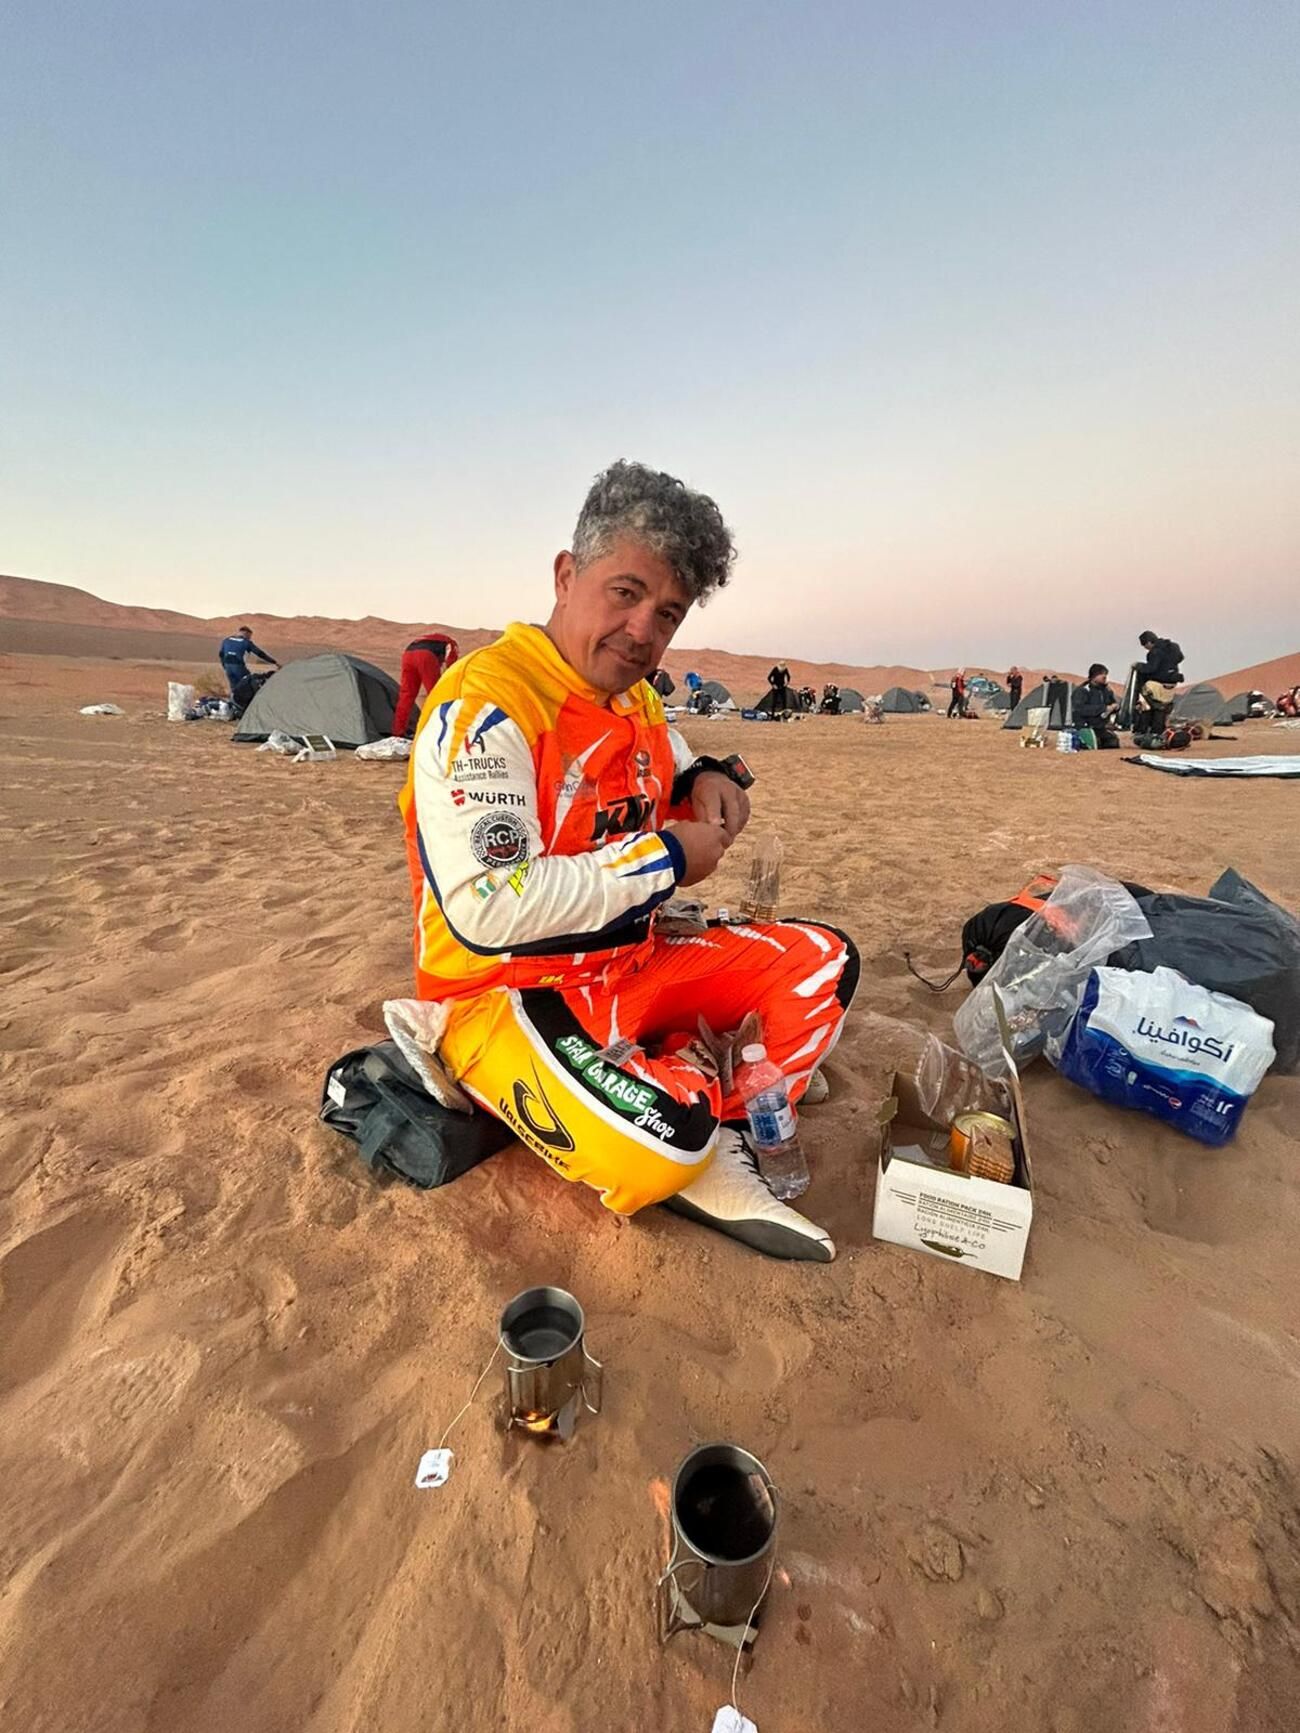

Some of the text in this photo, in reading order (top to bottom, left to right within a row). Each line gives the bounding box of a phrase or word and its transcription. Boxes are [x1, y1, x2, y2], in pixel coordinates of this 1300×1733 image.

[451, 757, 506, 772] TH-TRUCKS
[468, 791, 526, 806] WÜRTH
[484, 830, 519, 847] RCP
[1137, 1017, 1234, 1062] أكوافينا
[634, 1107, 675, 1140] Shop
[937, 1197, 960, 1208] RATION
